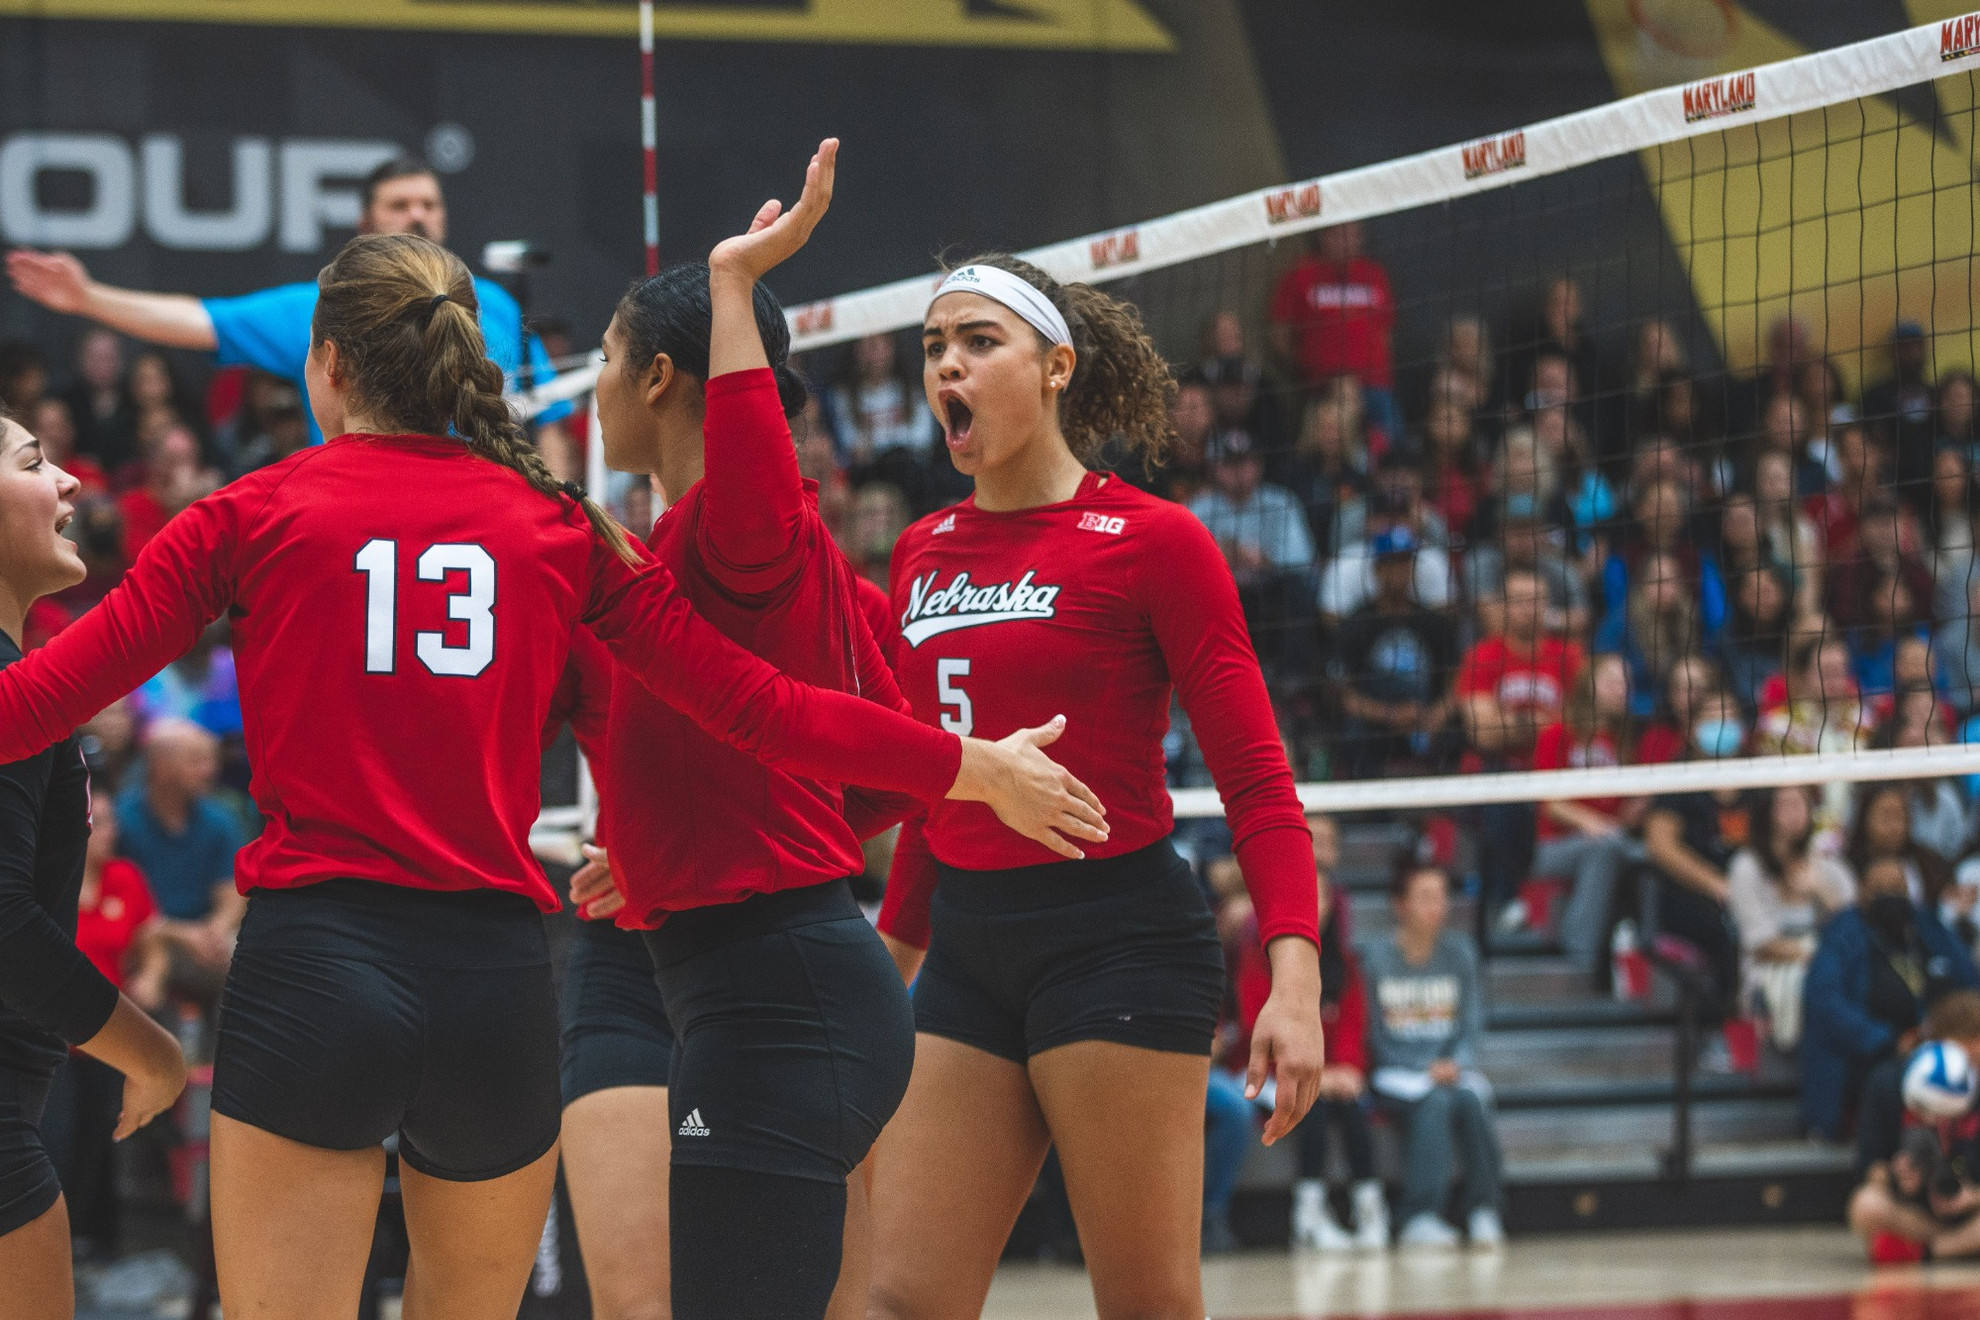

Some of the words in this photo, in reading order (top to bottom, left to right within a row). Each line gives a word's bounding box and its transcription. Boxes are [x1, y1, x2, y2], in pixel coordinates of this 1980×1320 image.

[1682, 72, 1755, 117] MARYLAND
[352, 537, 498, 680] 13
[901, 569, 1062, 627] Nebraska
[937, 658, 974, 738] 5
[678, 1125, 711, 1137] adidas
